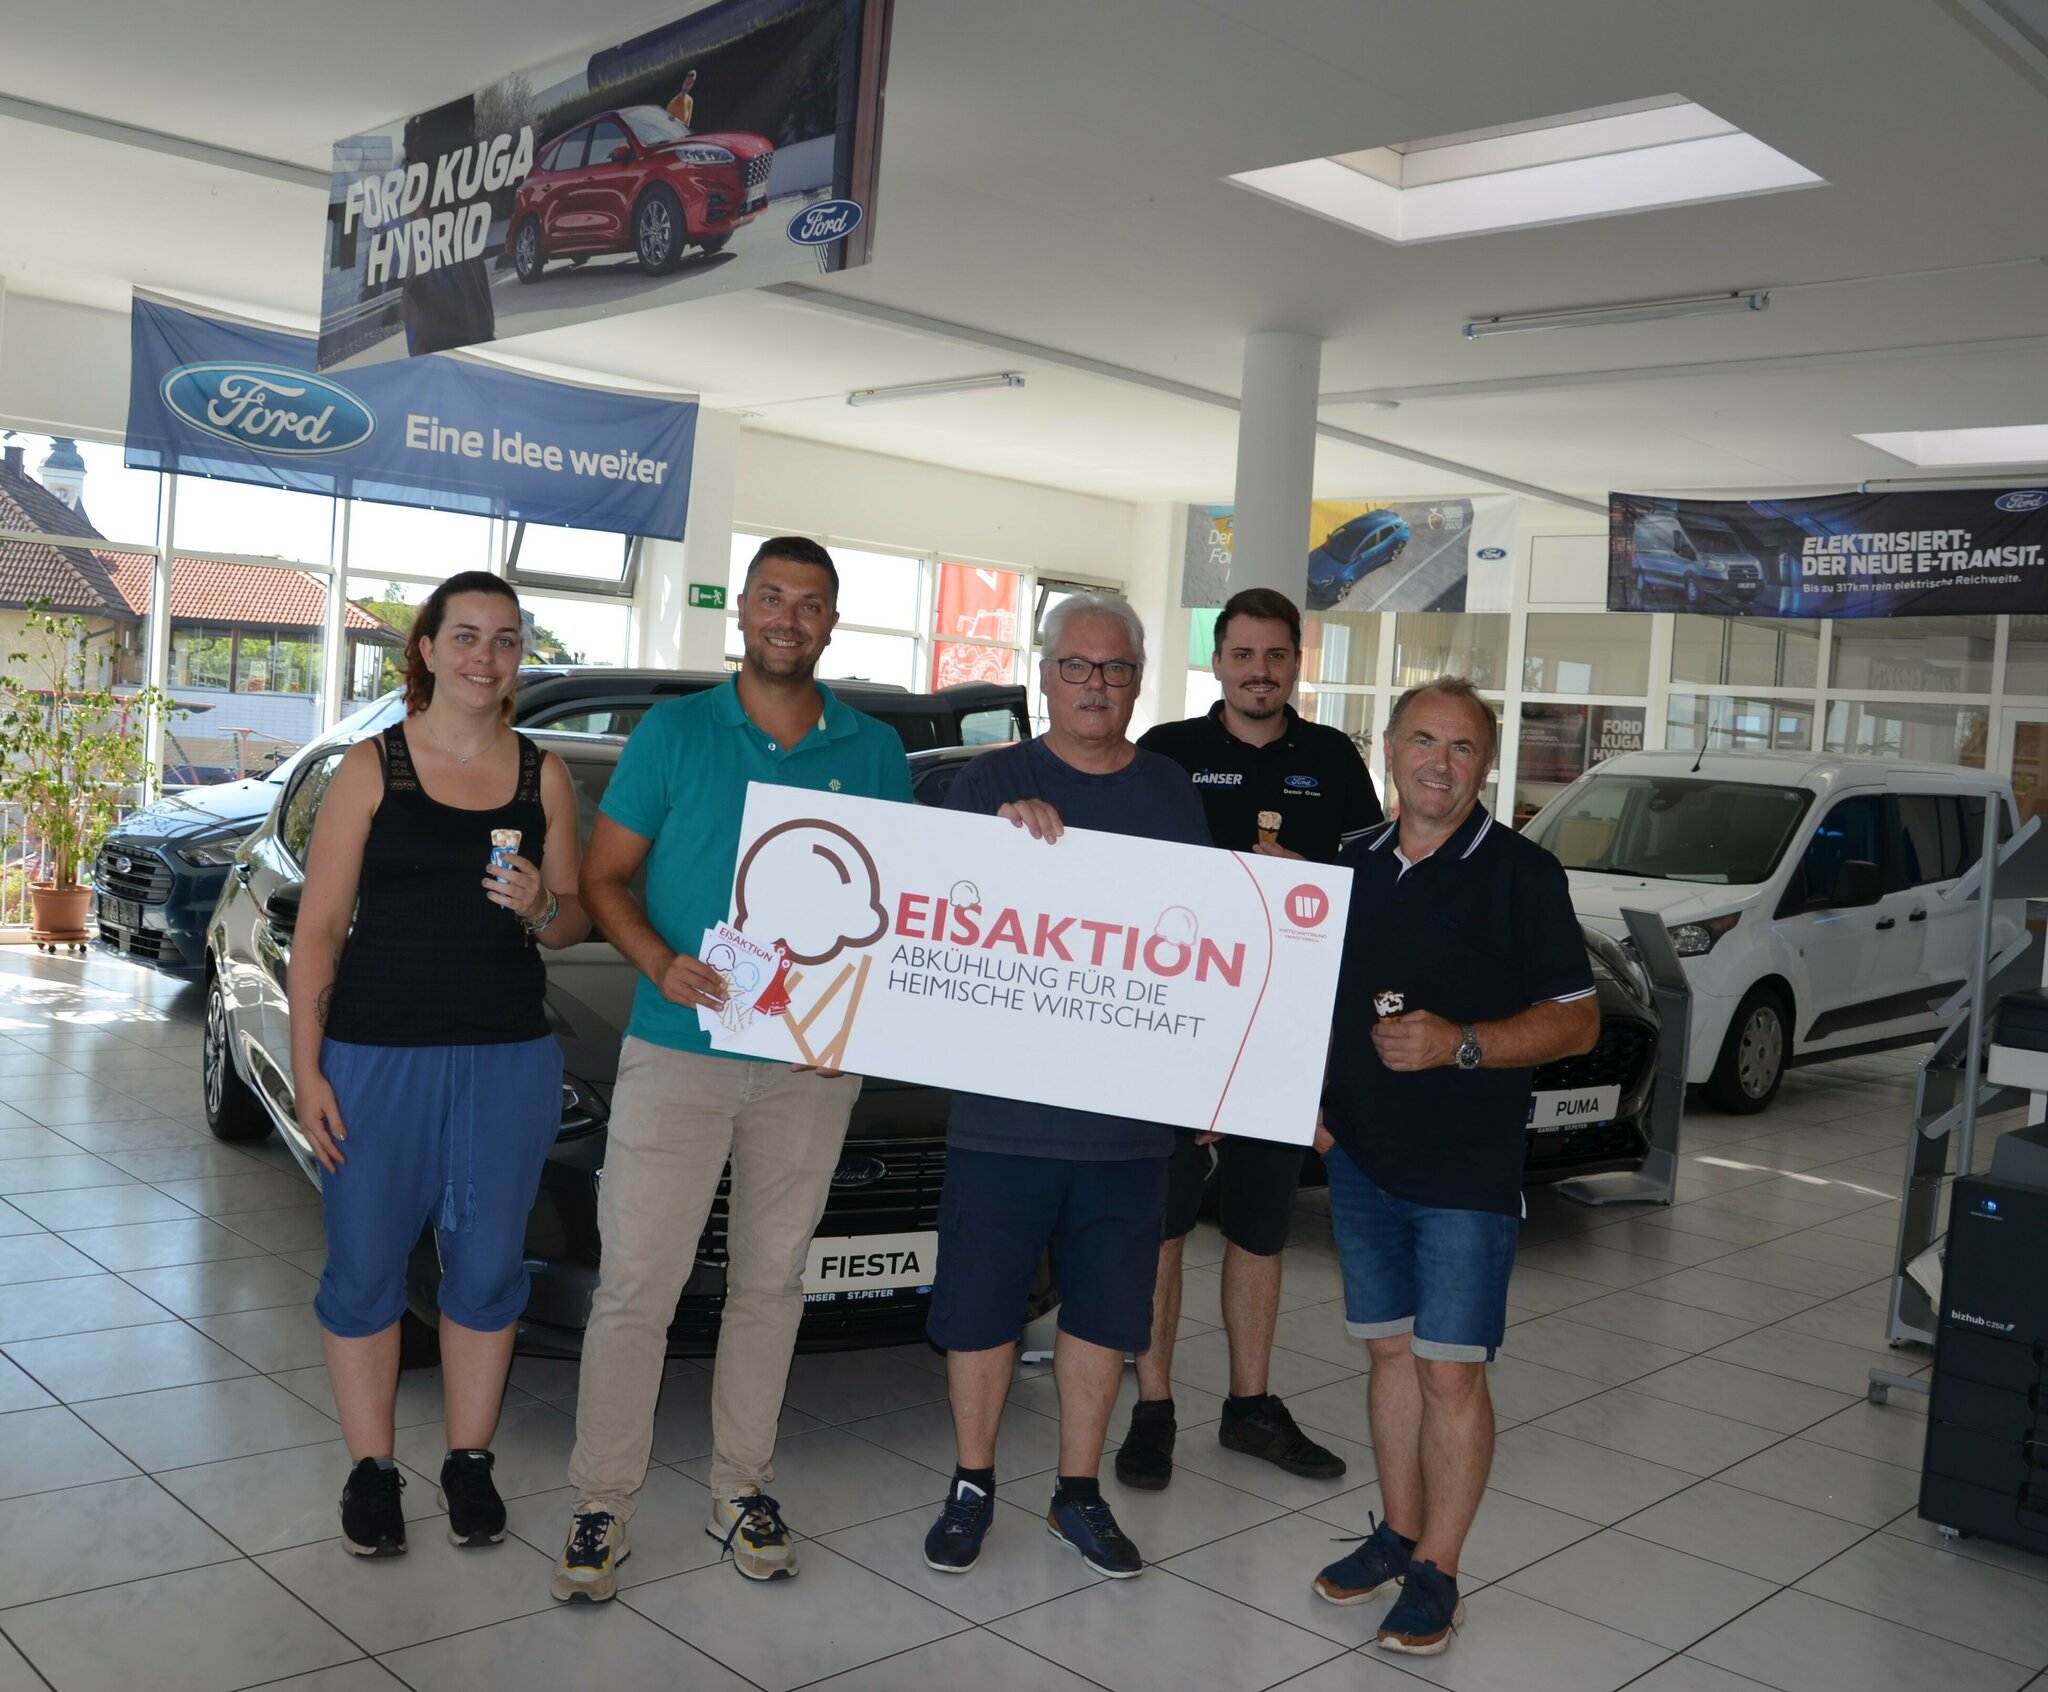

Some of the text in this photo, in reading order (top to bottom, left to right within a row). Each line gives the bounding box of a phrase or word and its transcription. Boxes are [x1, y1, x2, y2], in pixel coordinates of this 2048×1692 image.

[343, 125, 535, 235] FORD KUGA
[801, 206, 849, 240] Ford
[367, 201, 492, 287] HYBRID
[207, 374, 336, 445] Ford
[405, 414, 668, 485] Eine Idee weiter
[1801, 528, 1973, 555] ELEKTRISIERT:
[1801, 544, 2046, 577] DER NEUE E-TRANSIT.
[1802, 572, 2023, 594] Bis zu 317km rein elektrische Reichweite.
[1601, 734, 1642, 749] KUGA
[1602, 719, 1643, 735] FORD
[719, 927, 773, 963] EISAKTION
[894, 891, 1246, 988] EISAKTION
[890, 943, 1169, 1006] ABKÜHLUNG FÜR DIE
[888, 969, 1207, 1038] HEIMISCHE WIRTSCHAFT
[1556, 1098, 1599, 1117] PUMA
[820, 1251, 921, 1280] FIESTA
[847, 1289, 894, 1300] ST.PETER
[1951, 1310, 1985, 1326] bizhub
